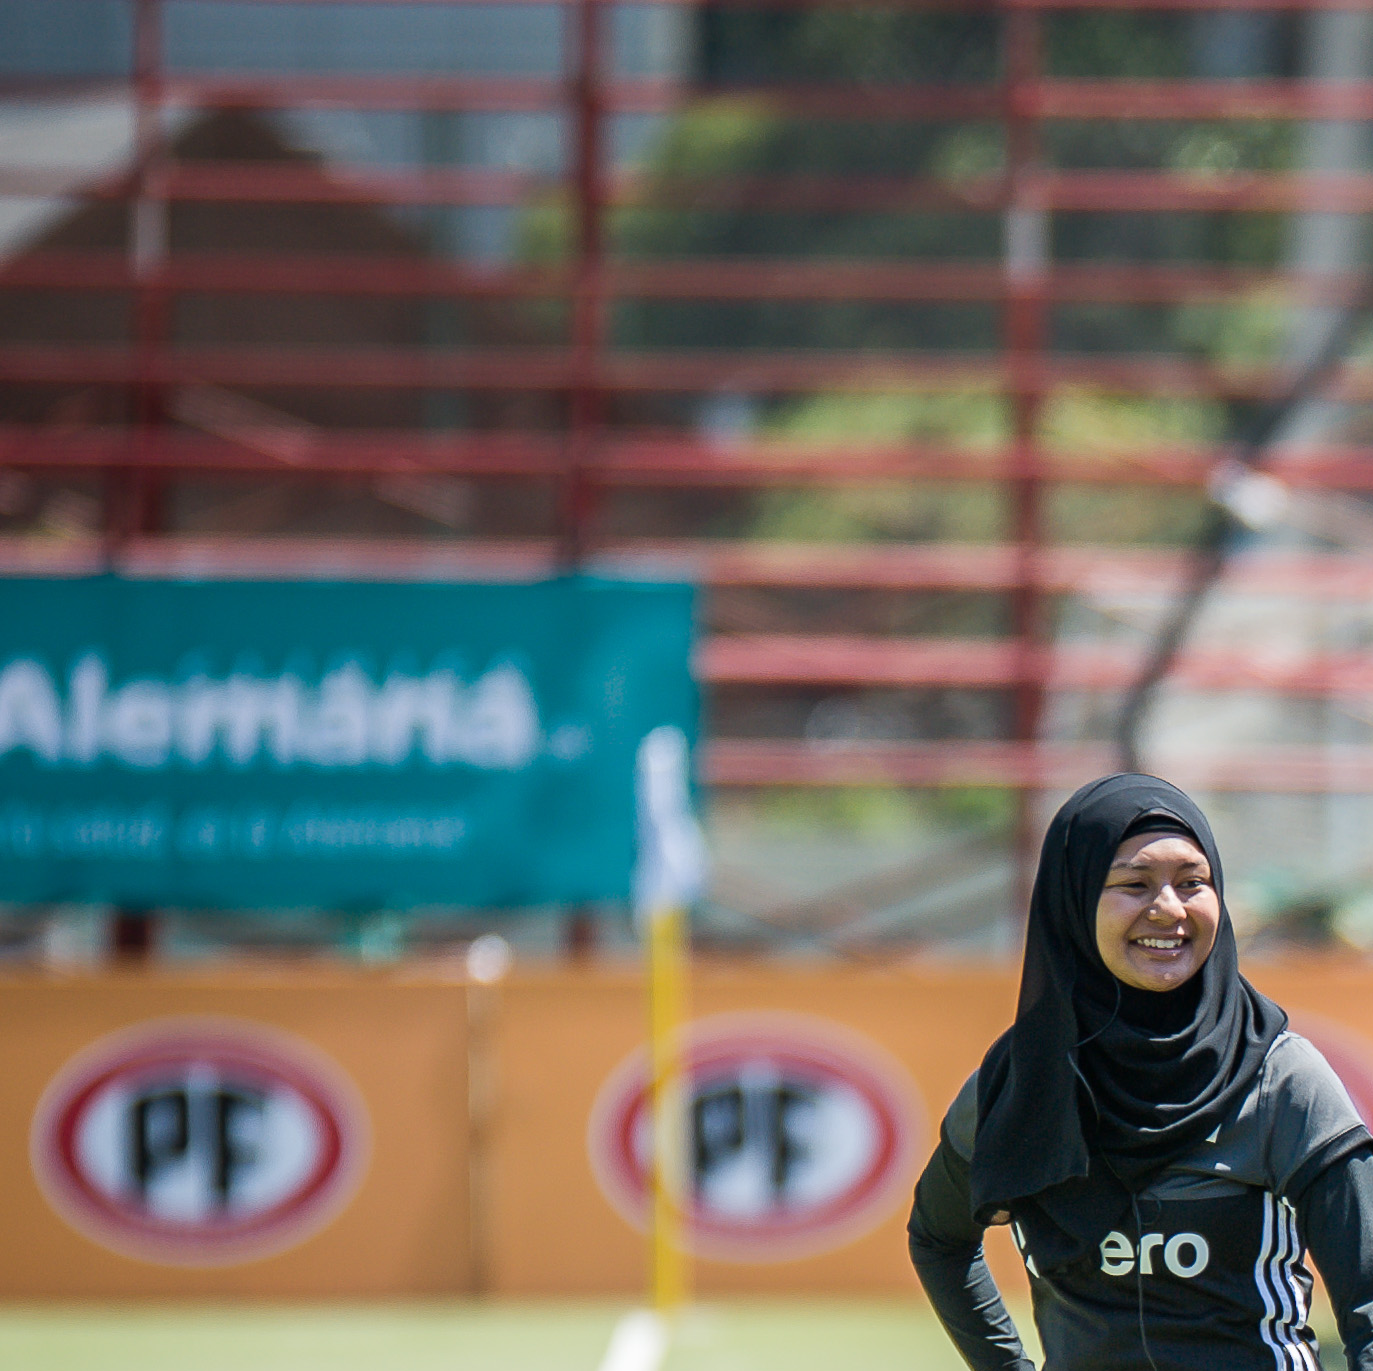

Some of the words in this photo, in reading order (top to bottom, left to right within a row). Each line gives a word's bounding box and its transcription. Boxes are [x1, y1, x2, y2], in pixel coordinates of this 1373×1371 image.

[128, 1085, 264, 1204] PF
[692, 1082, 822, 1200] PF
[1099, 1231, 1209, 1279] ero
